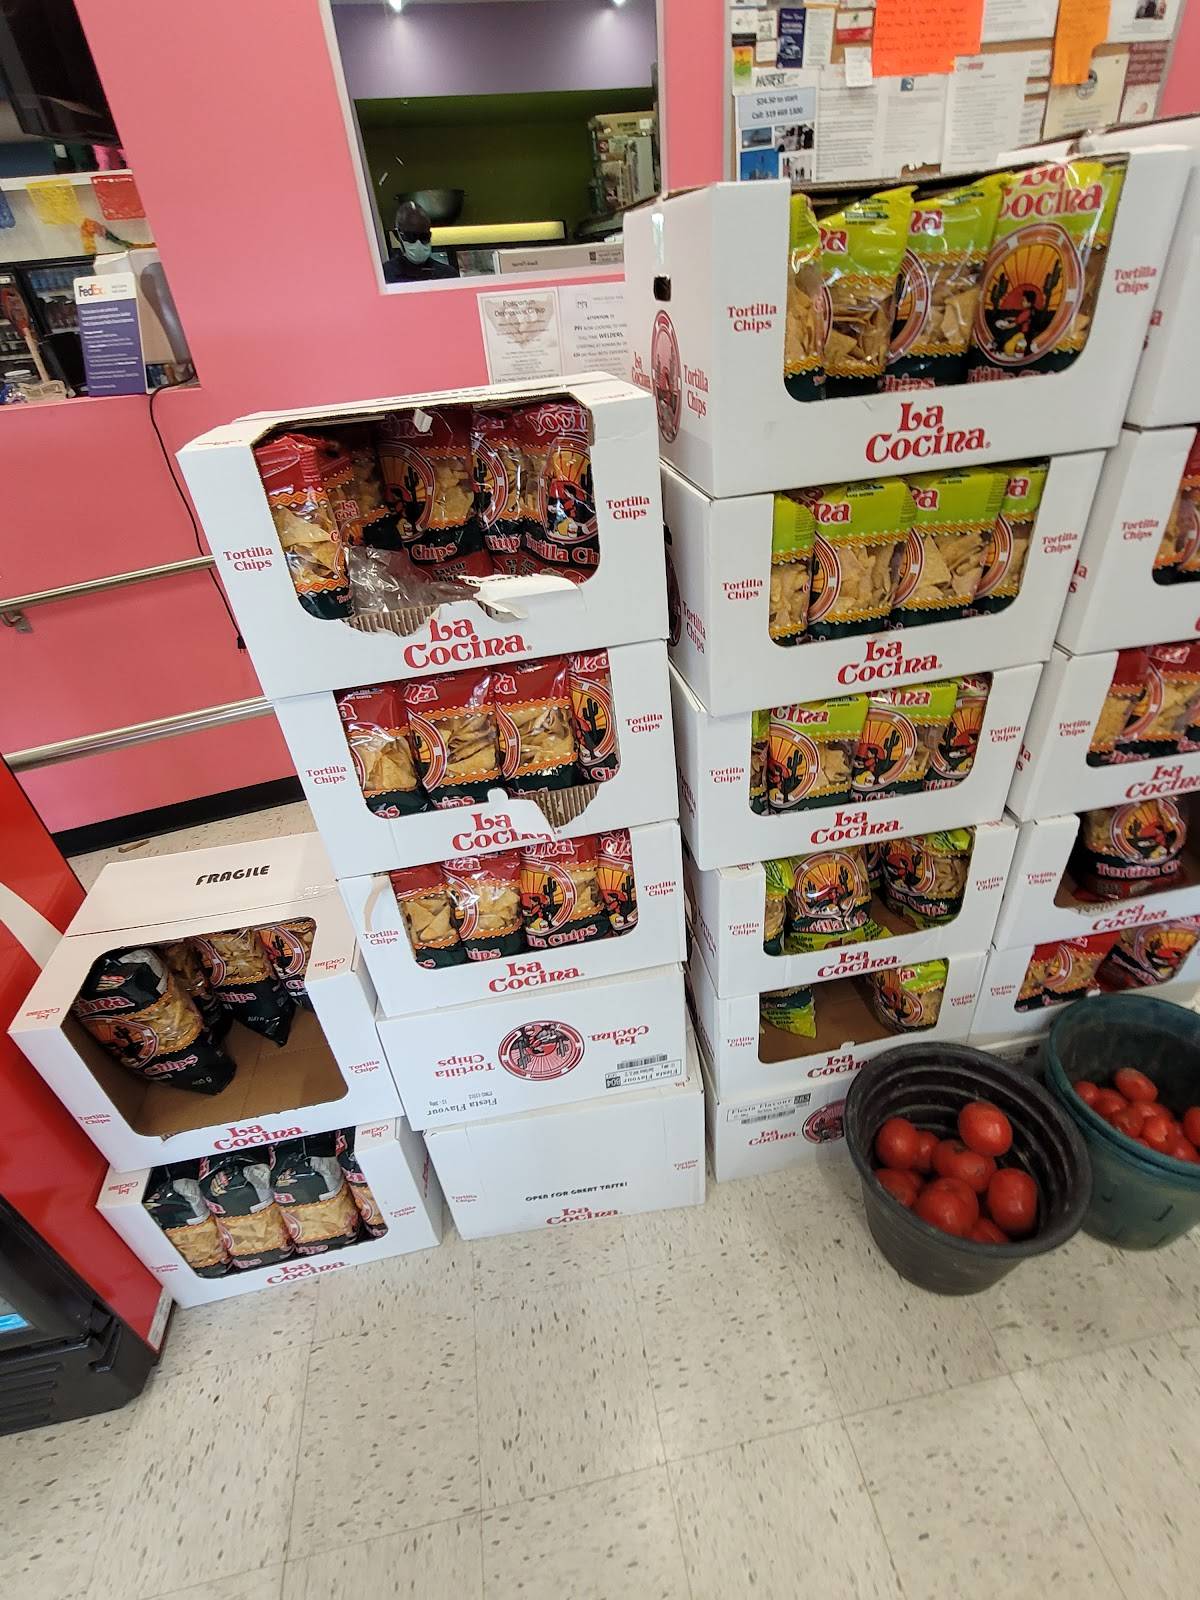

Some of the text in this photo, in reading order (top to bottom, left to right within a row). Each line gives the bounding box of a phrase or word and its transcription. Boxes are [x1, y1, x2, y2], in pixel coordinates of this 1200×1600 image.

[1114, 265, 1157, 281] Tortilla
[78, 283, 104, 297] FedEx
[1115, 281, 1149, 295] Chips
[727, 303, 777, 318] Tortilla
[733, 319, 772, 333] Chips
[684, 364, 709, 393] Tortilla
[687, 390, 707, 419] Chips
[898, 402, 943, 433] La
[865, 427, 987, 464] Cocina
[606, 495, 651, 510] Tortilla
[613, 508, 648, 521] Chips
[1122, 519, 1159, 531] Tortilla
[1041, 532, 1078, 545] Tortilla
[1123, 530, 1152, 541] Chips
[223, 546, 273, 561] Tortilla
[411, 543, 458, 562] Chips
[1044, 543, 1072, 554] Chips
[233, 559, 273, 571] Chips
[722, 578, 763, 592] Tortilla
[727, 588, 759, 601] Chips
[682, 600, 707, 640] Tortilla
[429, 618, 475, 643] La
[686, 622, 705, 654] Chips
[403, 634, 526, 669] Cocina
[864, 640, 903, 663] La
[837, 655, 938, 686] Cocina
[625, 713, 663, 727] Tortilla
[1059, 720, 1091, 730] Tortilla
[631, 722, 661, 735] Chips
[989, 725, 1021, 737] Tortilla
[1060, 728, 1085, 737] Chips
[991, 732, 1017, 743] Chips
[305, 765, 347, 778] Tortilla
[709, 767, 744, 777] Tortilla
[1152, 765, 1183, 780] La
[313, 775, 346, 786] Chips
[713, 774, 741, 783] Chips
[471, 812, 512, 832] La
[834, 811, 868, 828] La
[810, 820, 900, 845] Cocina
[195, 865, 270, 886] FRAGILE
[975, 876, 1004, 887] Tortilla
[1027, 872, 1057, 880] Tortilla
[643, 881, 676, 892] Tortilla
[649, 888, 674, 897] Chips
[977, 884, 1000, 892] Chips
[727, 922, 760, 931] Tortilla
[1092, 910, 1167, 930] Cocina
[363, 929, 399, 940] Tortilla
[550, 925, 598, 946] Chips
[731, 928, 757, 936] Chips
[370, 937, 398, 946] Chips
[314, 957, 345, 968] Cocina
[839, 951, 869, 964] La
[506, 961, 542, 977] La
[817, 956, 898, 977] Cocina
[489, 967, 581, 993] Cocina
[990, 984, 1016, 992] Tortilla
[950, 993, 976, 1004] Tortilla
[952, 999, 973, 1007] Chips
[591, 1025, 649, 1042] Cocina
[615, 1035, 637, 1046] La
[727, 1036, 755, 1045] Tortilla
[349, 1060, 380, 1072] Tortilla
[437, 1053, 485, 1067] Chips
[826, 1054, 853, 1067] La
[354, 1066, 379, 1074] Chips
[434, 1063, 496, 1079] Tortilla
[427, 1103, 467, 1116] Flavour
[467, 1098, 497, 1110] Fiesta
[78, 1113, 111, 1123] Tortilla
[227, 1124, 264, 1138] La
[214, 1126, 304, 1151] Cocina
[749, 1132, 796, 1146] Cocina
[674, 1159, 699, 1168] Tortilla
[390, 1205, 417, 1215] Tortilla
[393, 1210, 416, 1218] Chips
[561, 1206, 589, 1216] La
[546, 1210, 618, 1226] Cocina
[266, 1262, 345, 1284] Cocina
[280, 1262, 311, 1274] La
